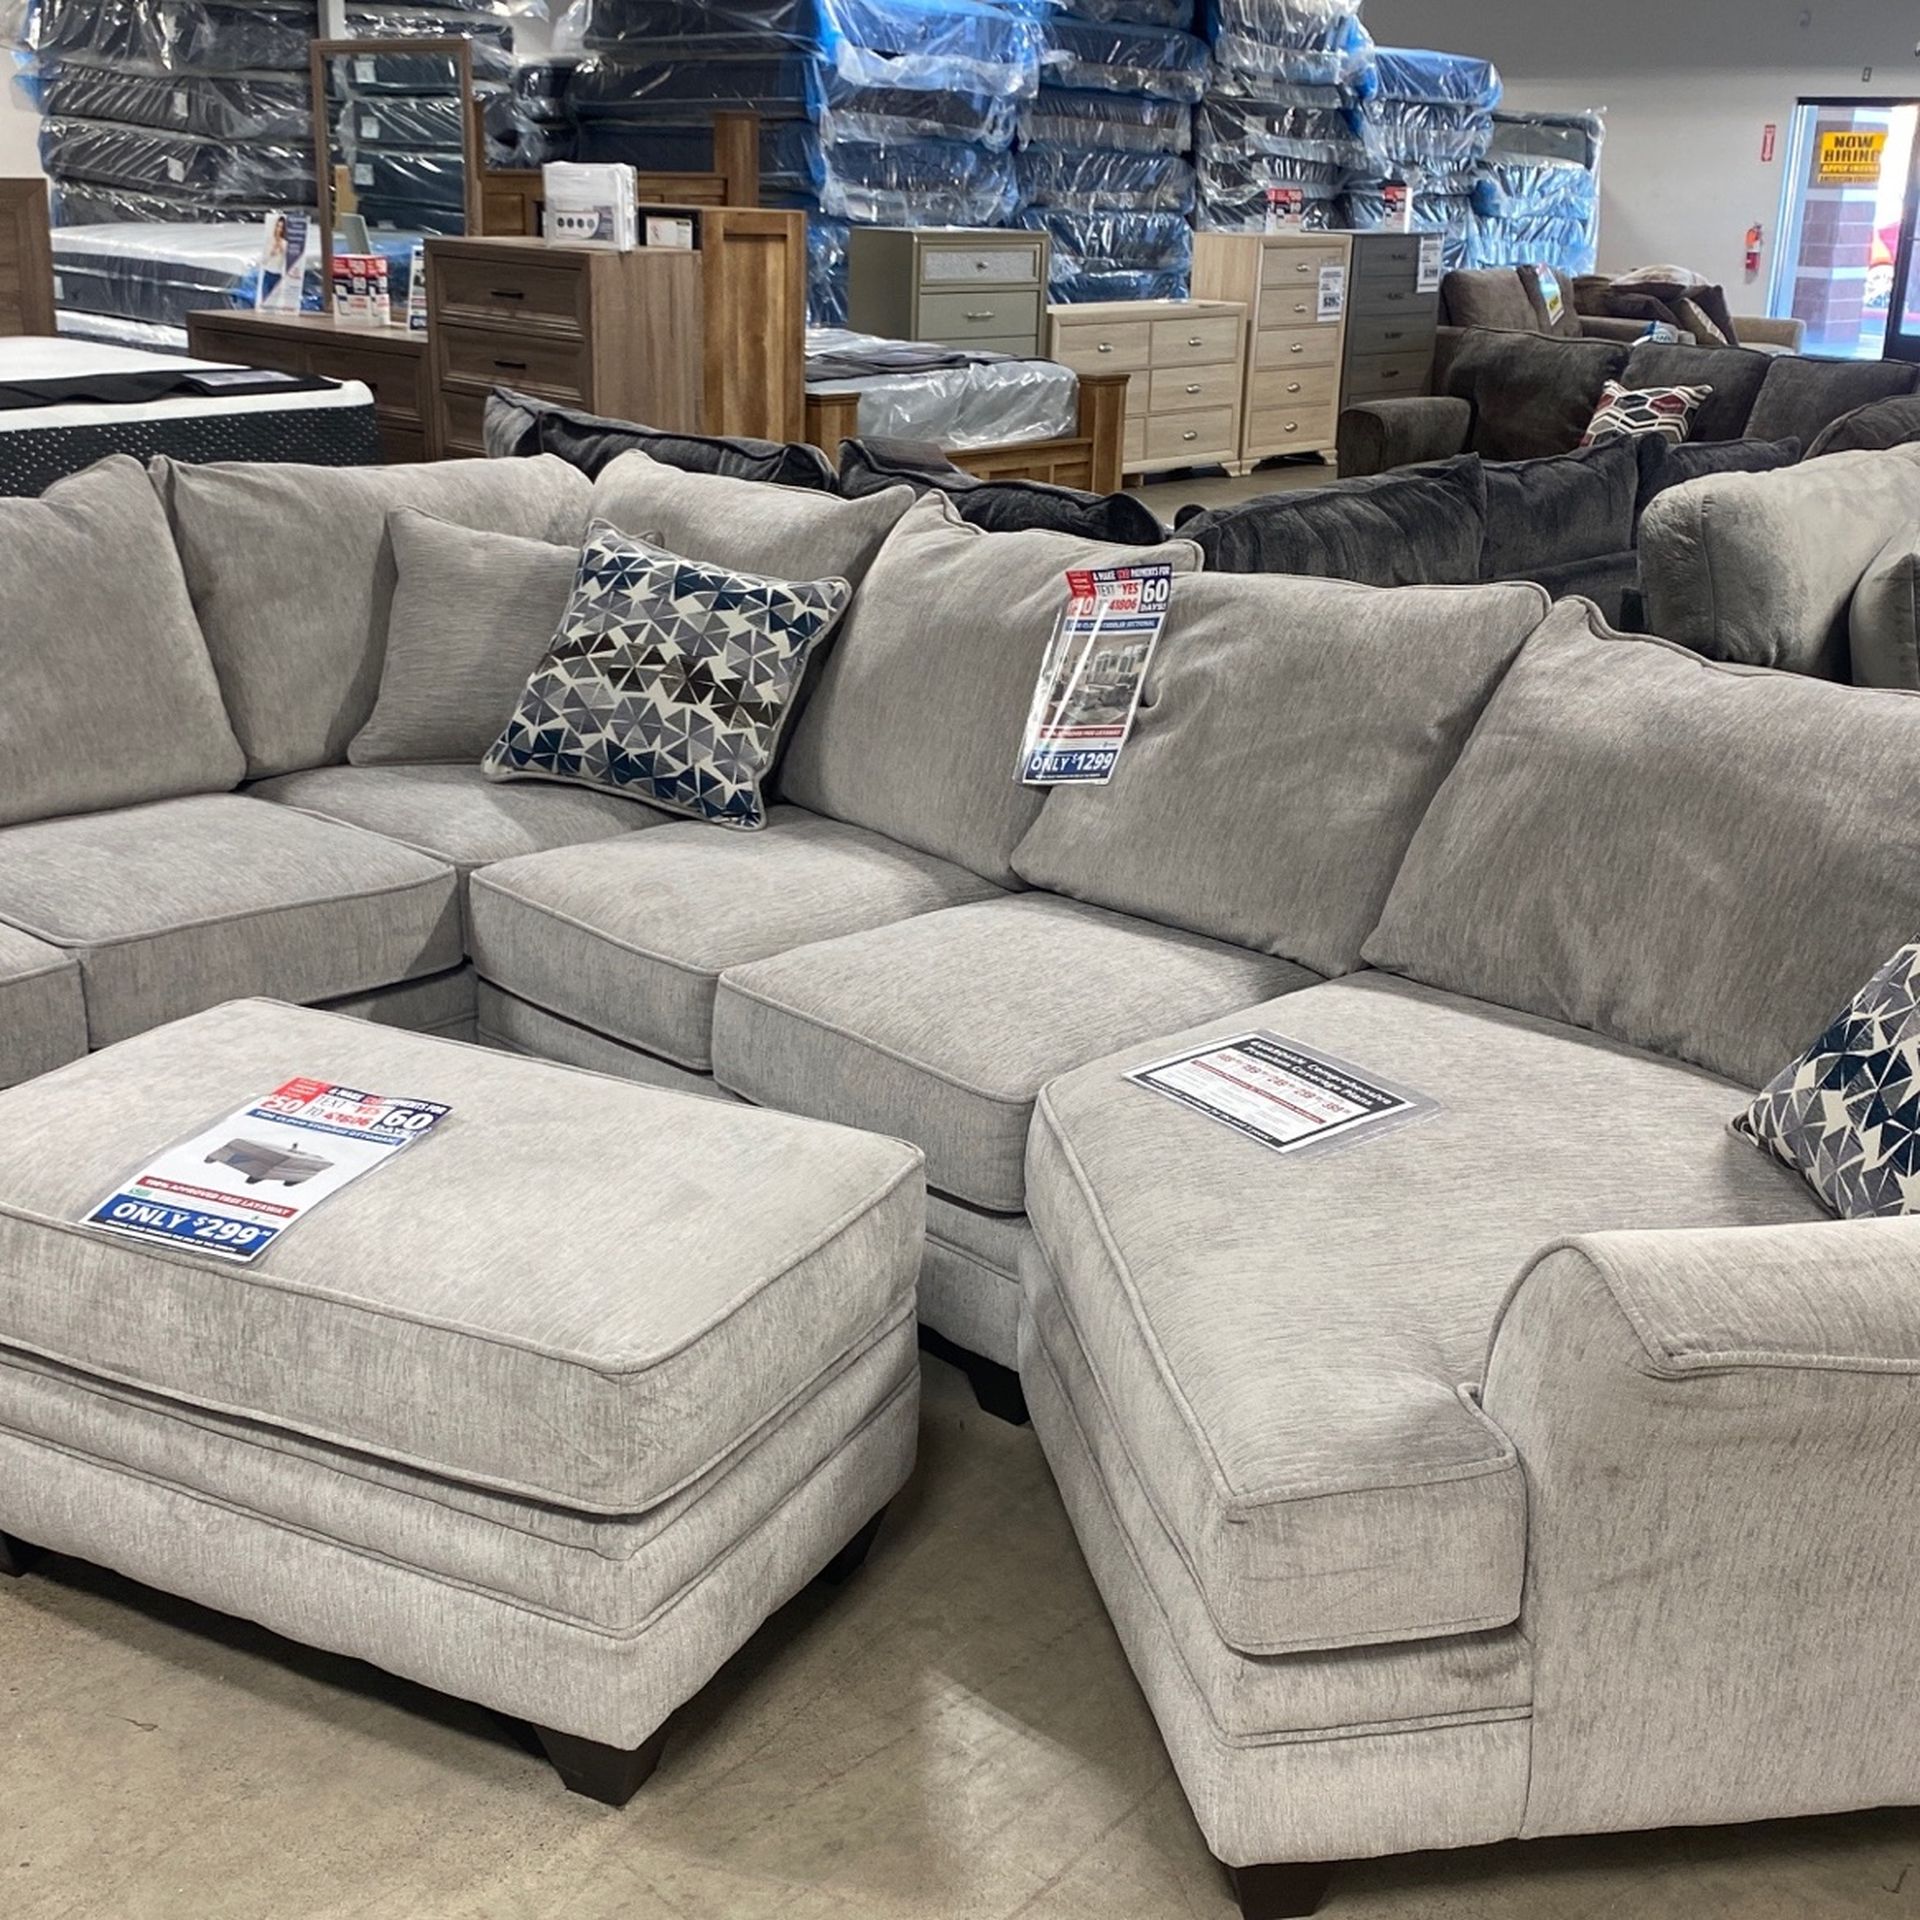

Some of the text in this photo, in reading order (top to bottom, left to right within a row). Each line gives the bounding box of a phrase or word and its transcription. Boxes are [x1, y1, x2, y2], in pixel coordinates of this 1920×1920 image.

[1834, 136, 1873, 148] NOW
[1143, 578, 1169, 603] 60
[1031, 752, 1114, 771] ONLY $1299
[382, 1109, 434, 1131] 60
[112, 1202, 191, 1229] ONLY
[242, 1200, 290, 1215] LAYAWAY
